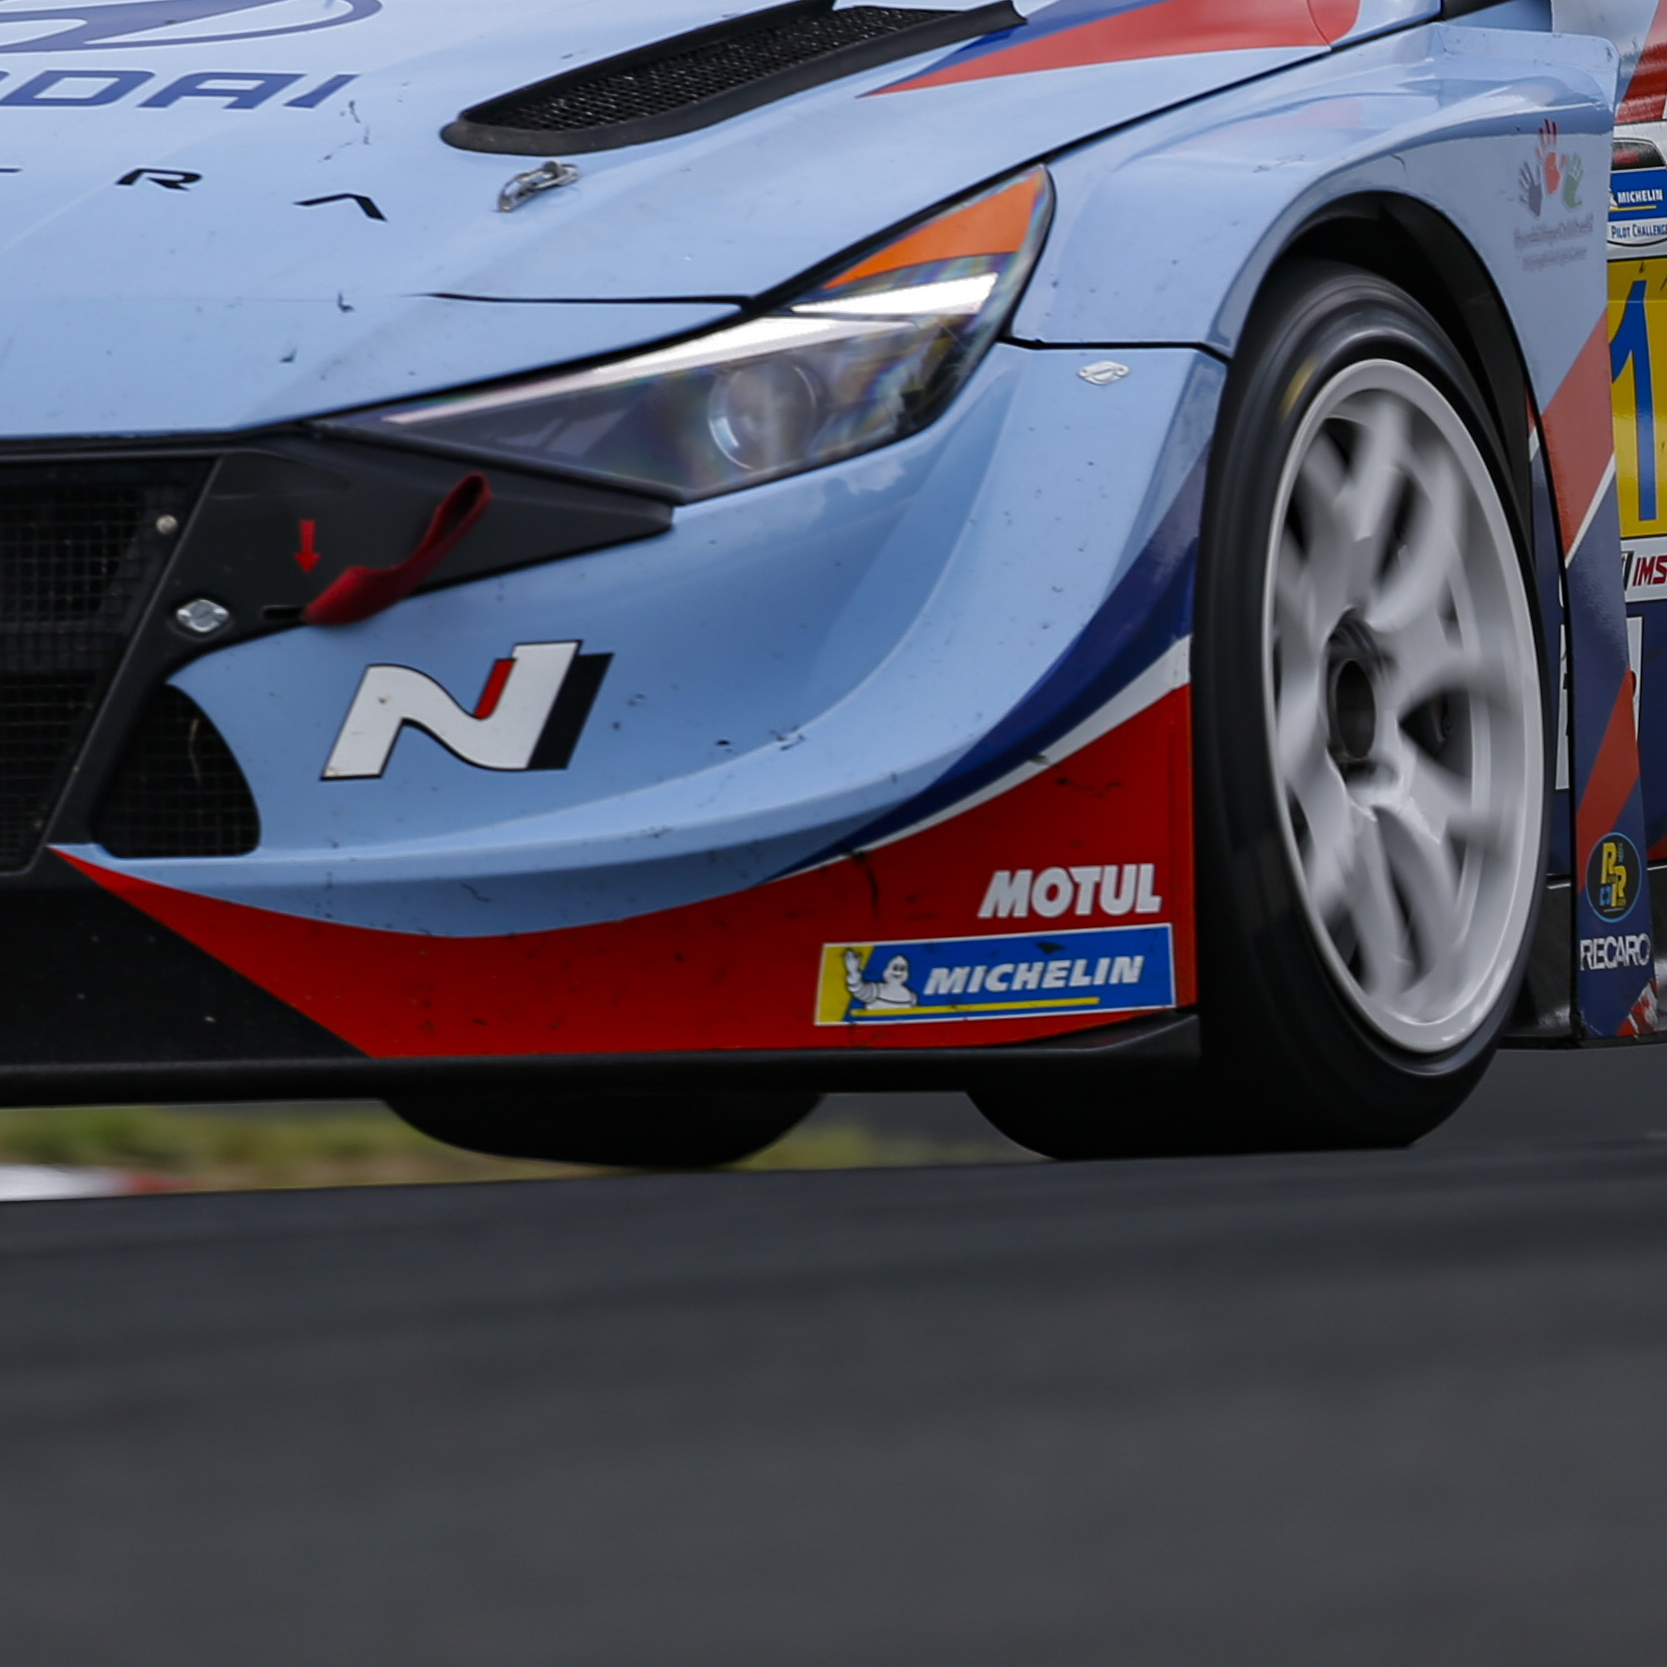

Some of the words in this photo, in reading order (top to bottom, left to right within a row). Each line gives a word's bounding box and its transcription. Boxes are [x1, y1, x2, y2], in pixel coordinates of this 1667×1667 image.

[1616, 188, 1664, 204] MICHELIN
[1611, 225, 1630, 239] PILOT
[1609, 280, 1658, 522] 1
[319, 639, 615, 782] N
[976, 863, 1163, 919] MOTUL
[1580, 933, 1652, 971] RECARO
[923, 955, 1145, 996] MICHELIN
